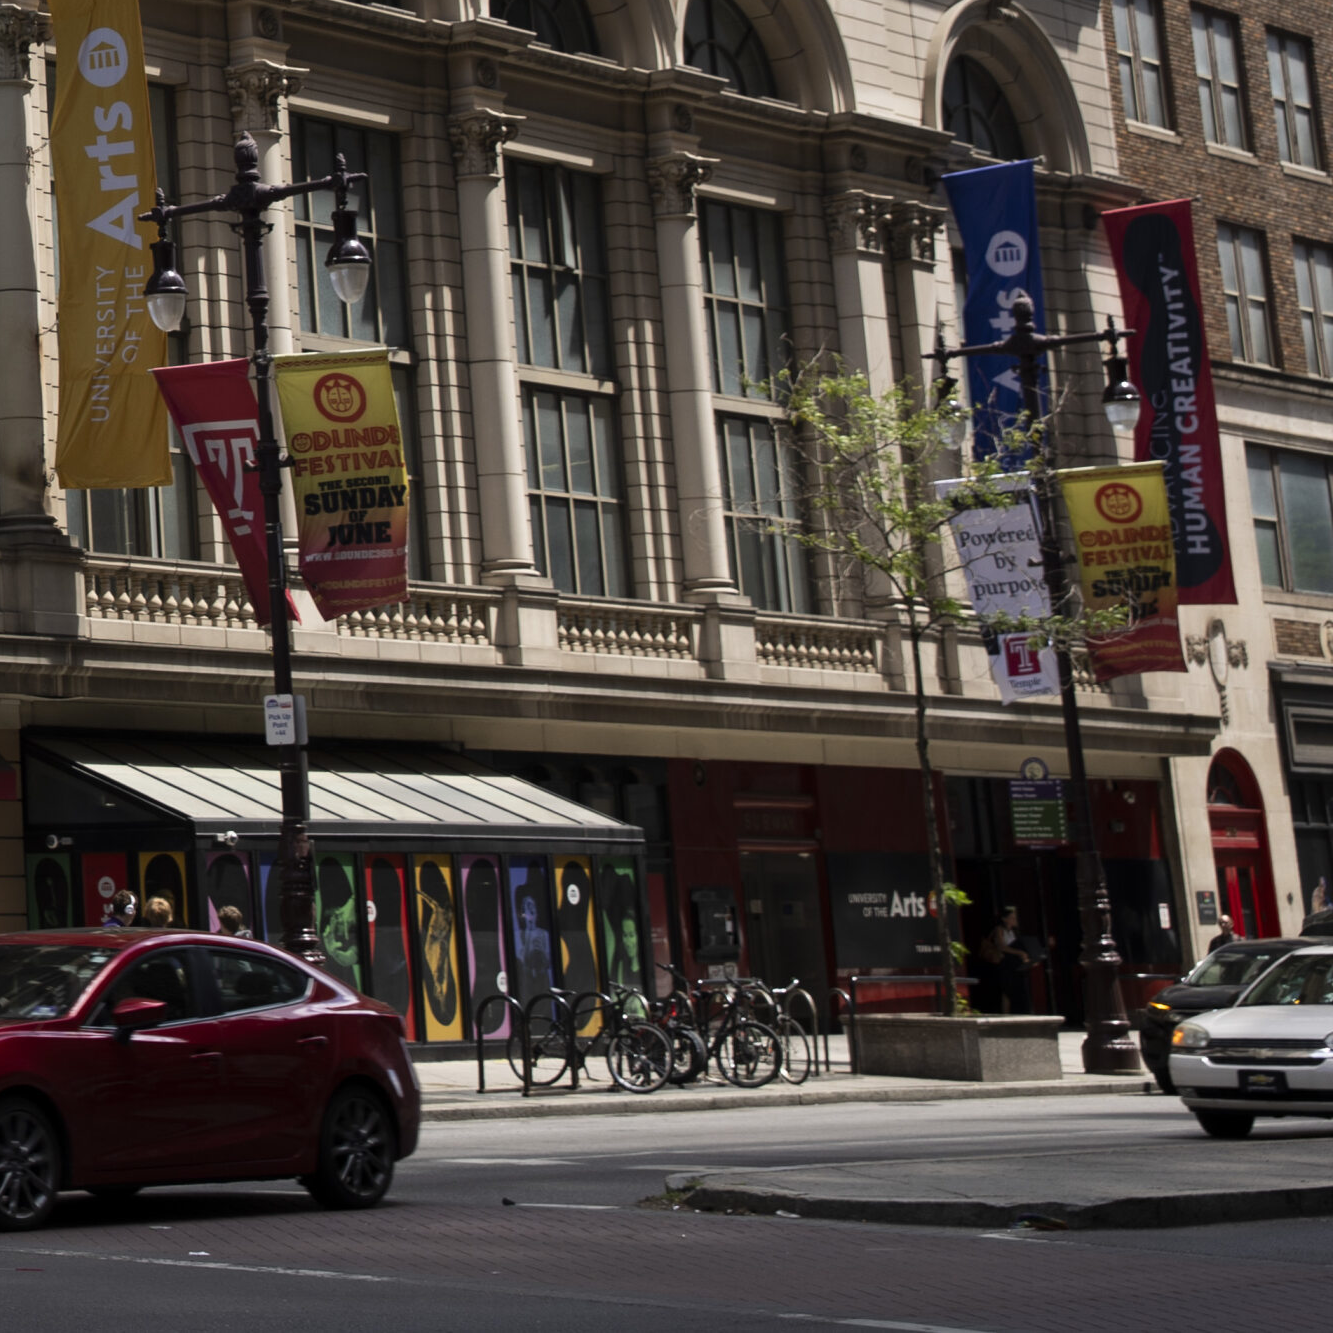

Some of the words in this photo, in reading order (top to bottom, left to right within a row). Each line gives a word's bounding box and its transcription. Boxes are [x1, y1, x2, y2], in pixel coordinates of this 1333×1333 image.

[84, 100, 143, 251] Arts
[125, 264, 145, 319] THE
[91, 266, 116, 423] UNIVERSITY
[121, 329, 142, 364] OF
[291, 425, 401, 453] ODUNDE
[294, 449, 405, 477] FESTIVAL
[318, 479, 343, 492] THE
[346, 476, 390, 488] SECOND
[304, 485, 407, 516] SUNDAY
[1178, 444, 1211, 555] HUMAN
[349, 510, 368, 523] OF
[328, 521, 392, 547] JUNE
[958, 524, 1036, 548] Powered
[1079, 525, 1171, 547] ODUNDE
[994, 552, 1017, 572] by
[1082, 544, 1172, 567] FESTIVAL
[972, 578, 1047, 600] purpose
[848, 893, 887, 903] UNIVERSITY
[890, 890, 927, 918] Arts
[863, 907, 871, 917] OF
[873, 907, 888, 917] THE
